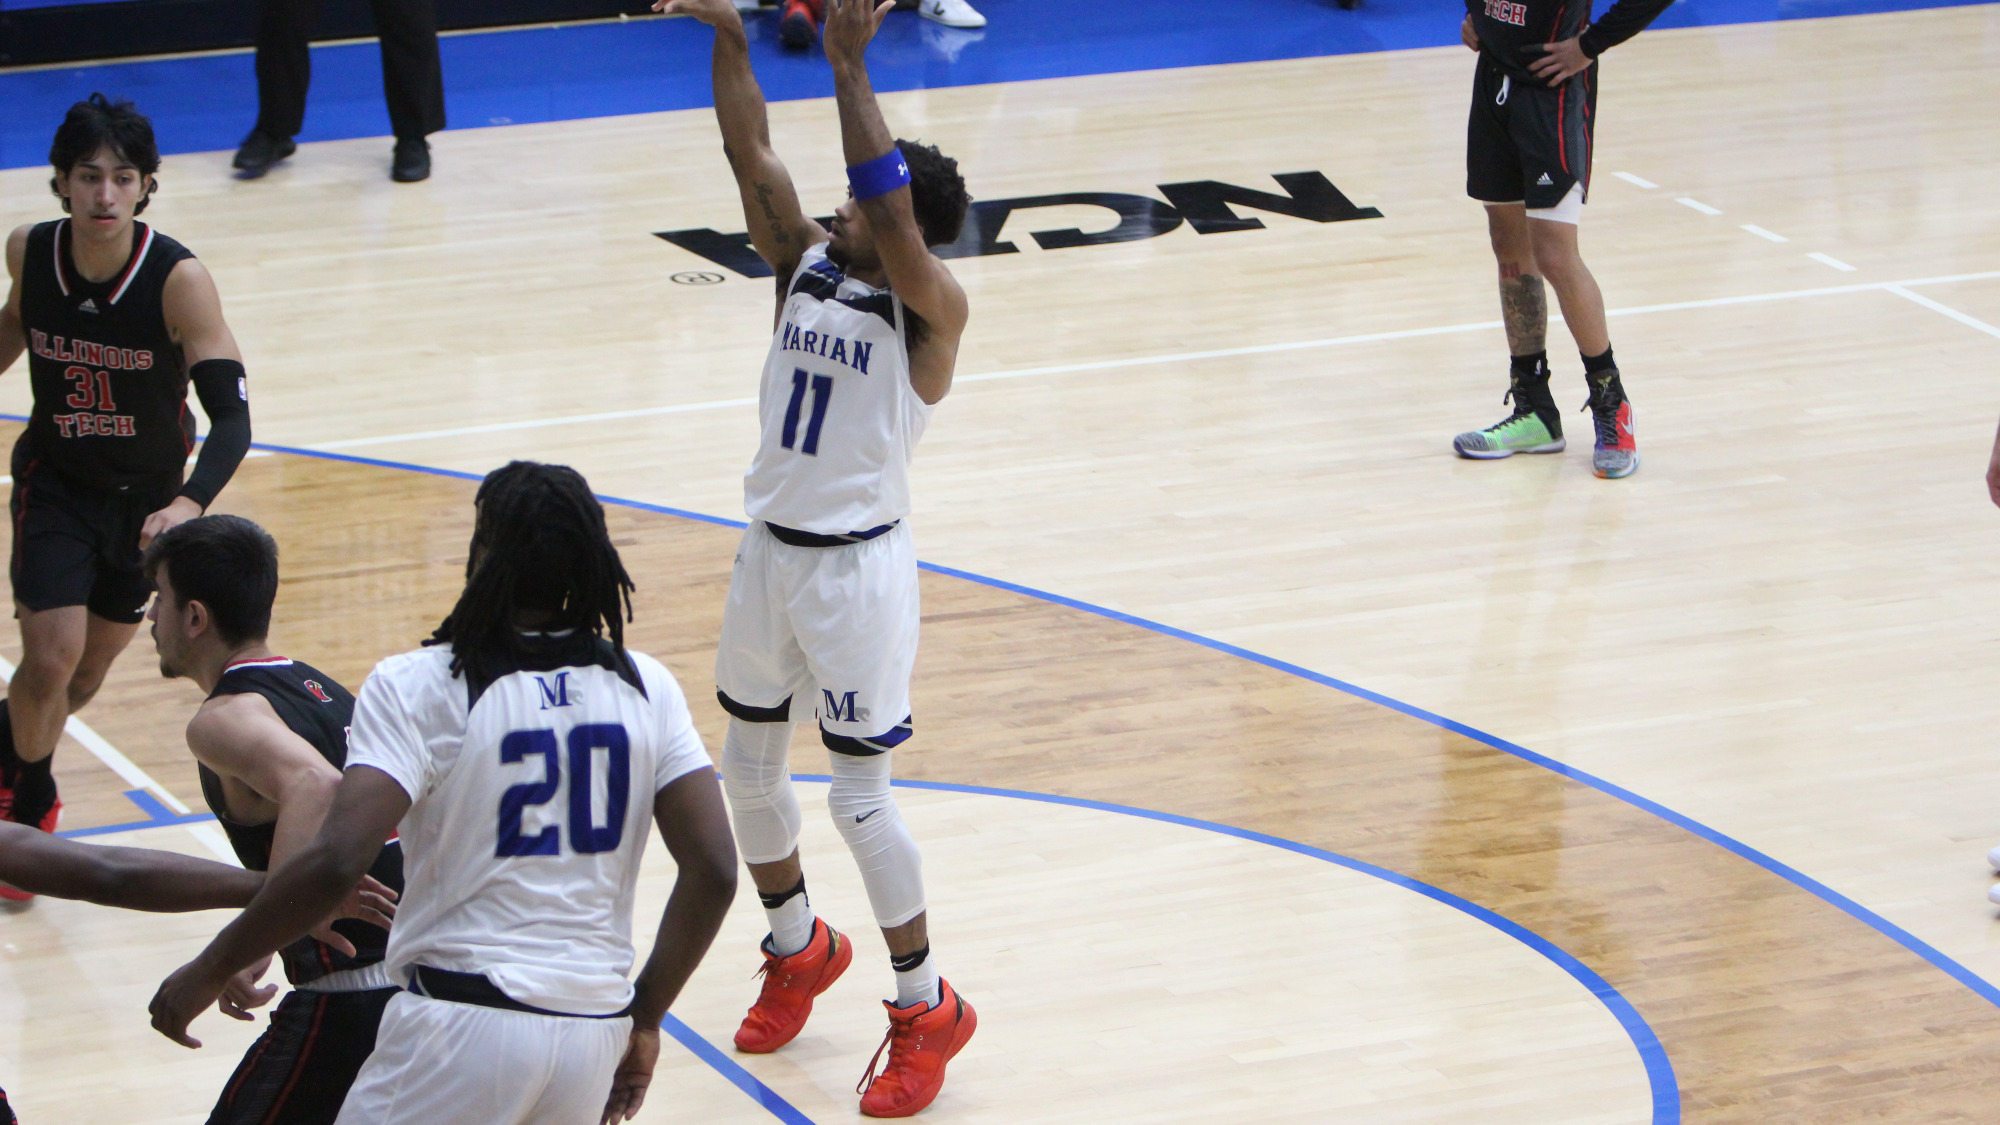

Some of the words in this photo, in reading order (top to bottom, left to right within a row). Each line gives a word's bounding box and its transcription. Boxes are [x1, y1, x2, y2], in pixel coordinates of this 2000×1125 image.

[1483, 0, 1527, 26] TECH
[31, 328, 153, 370] ILLINOIS
[779, 321, 873, 375] MARIAN
[64, 365, 116, 411] 31
[53, 412, 136, 438] TECH
[781, 367, 834, 457] 11
[534, 672, 573, 710] M
[822, 688, 860, 723] M
[495, 722, 631, 859] 20
